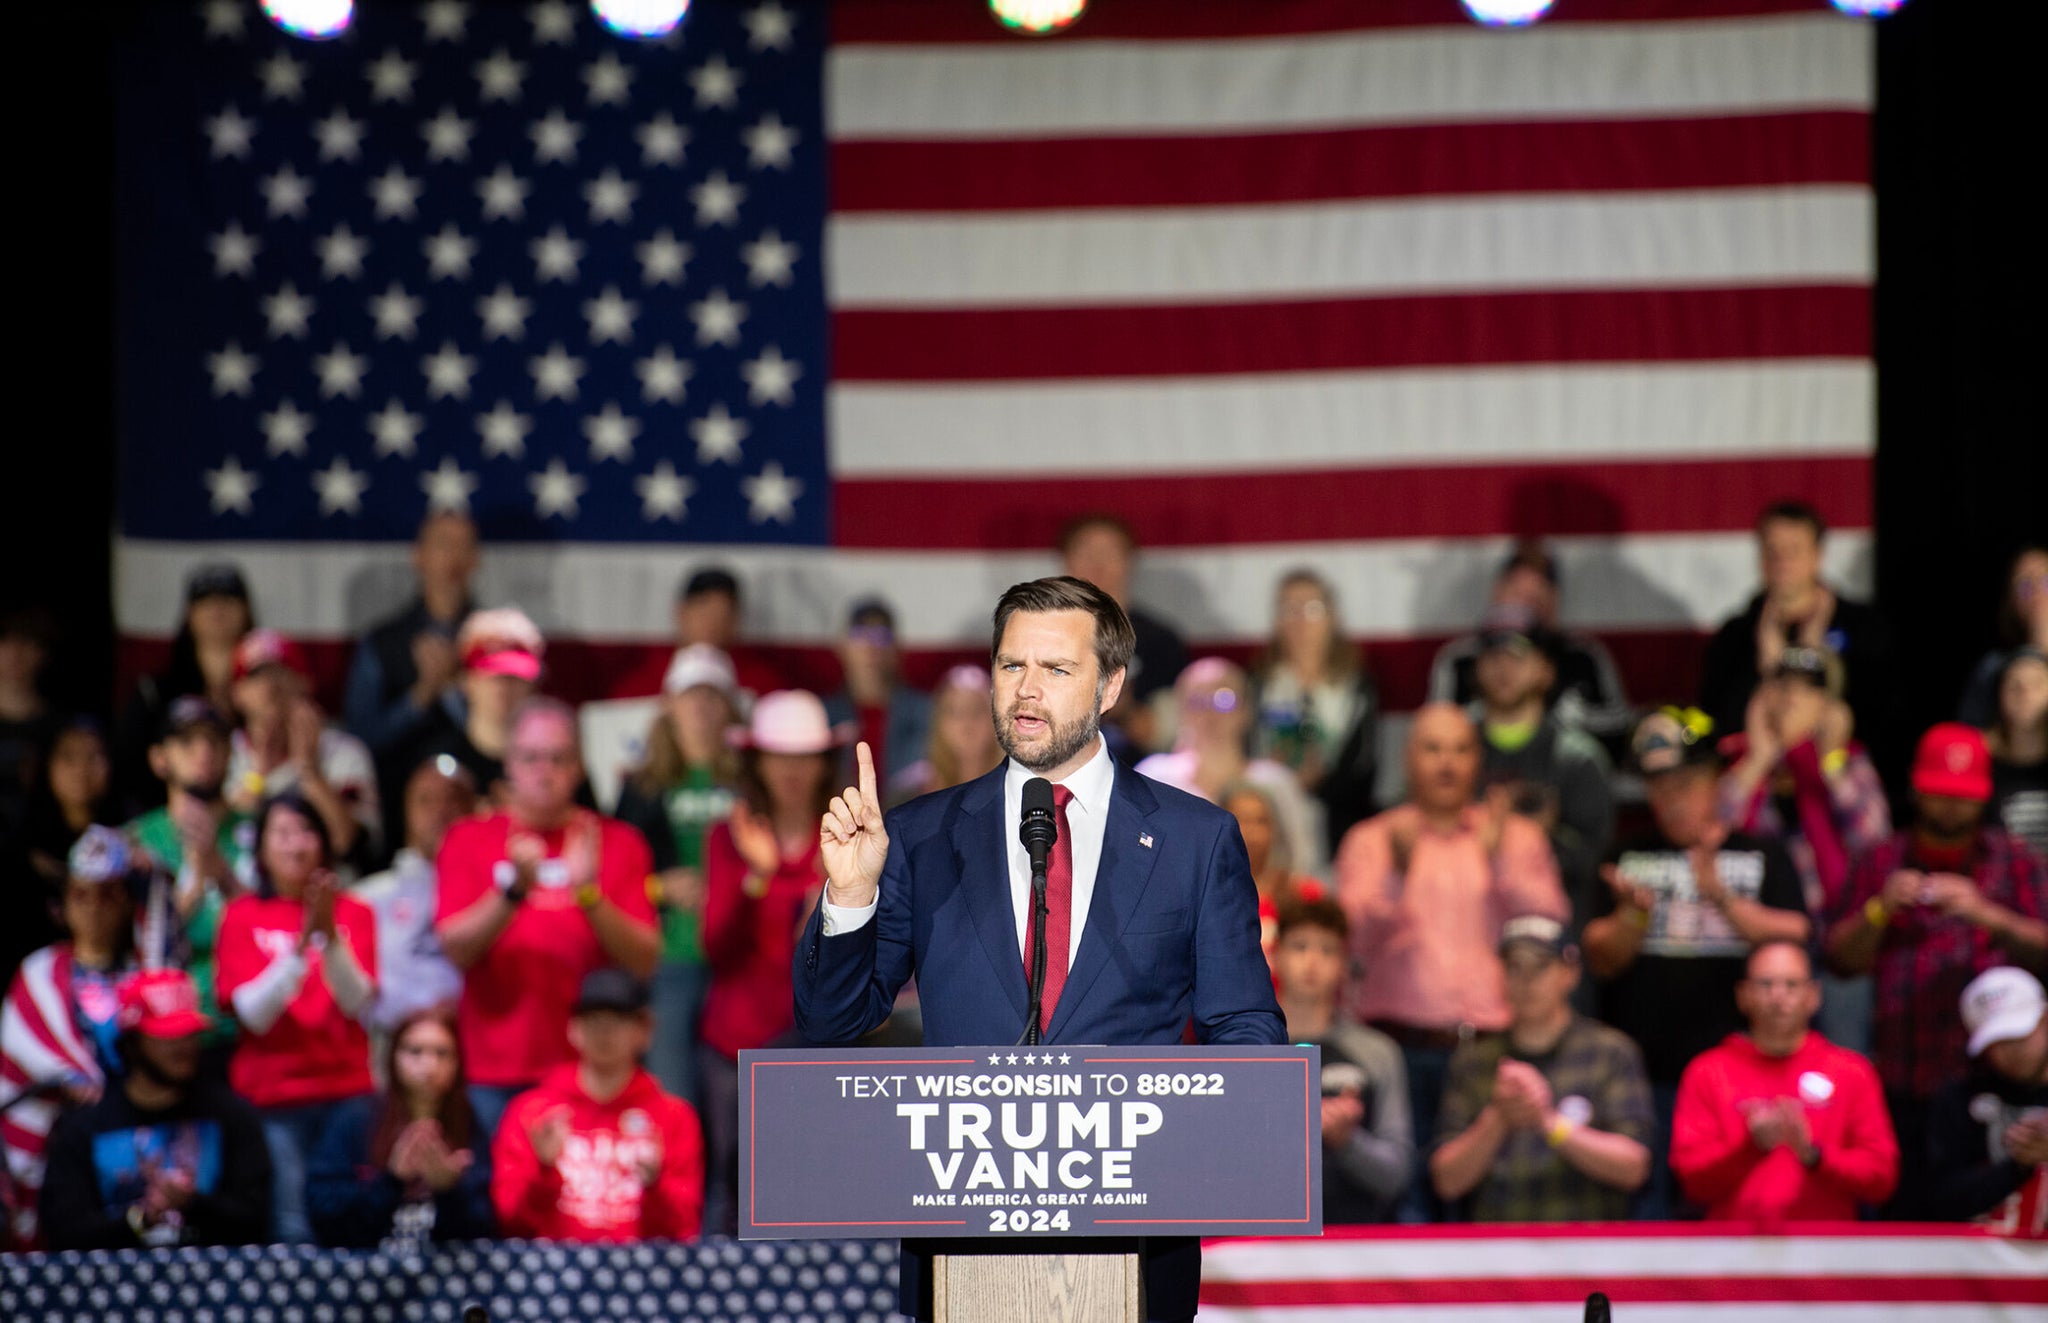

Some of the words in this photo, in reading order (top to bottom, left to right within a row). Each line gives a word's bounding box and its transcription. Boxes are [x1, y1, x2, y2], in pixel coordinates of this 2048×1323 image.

[835, 1075, 908, 1098] TEXT
[915, 1073, 1083, 1098] WISCONSIN
[1089, 1073, 1129, 1096] TO
[1136, 1073, 1225, 1096] 88022
[896, 1101, 1164, 1150] TRUMP
[926, 1150, 1133, 1190] VANCE
[912, 1194, 957, 1207] MAKE
[960, 1193, 1033, 1206] AMERICA
[1036, 1193, 1088, 1206] GREAT
[1091, 1192, 1148, 1205] AGAIN!
[988, 1209, 1071, 1232] 2024
